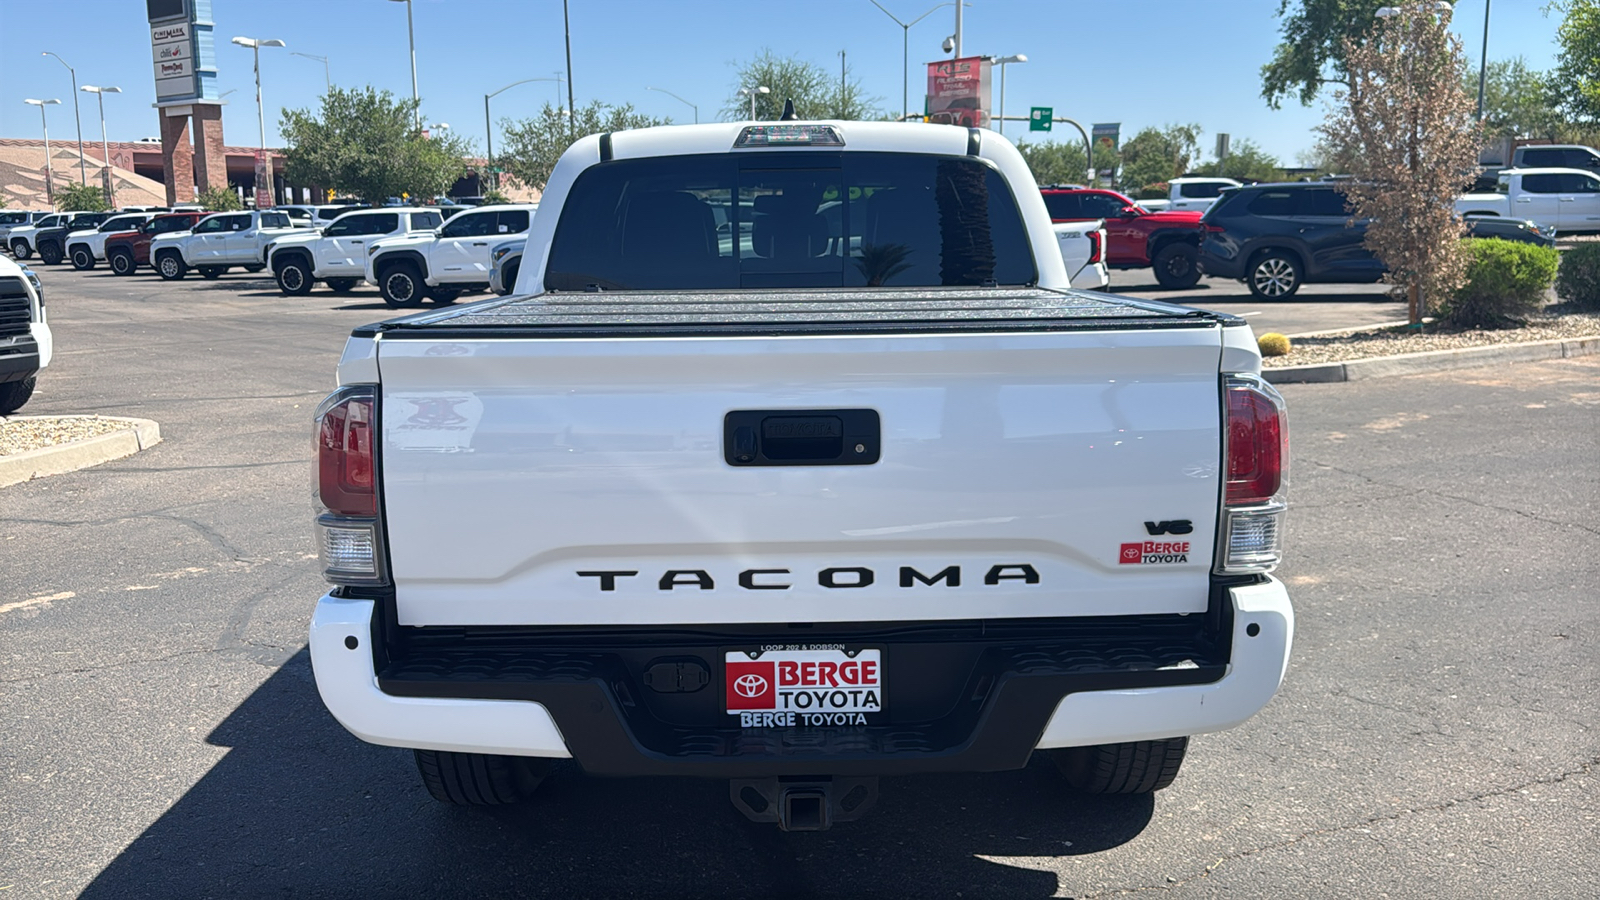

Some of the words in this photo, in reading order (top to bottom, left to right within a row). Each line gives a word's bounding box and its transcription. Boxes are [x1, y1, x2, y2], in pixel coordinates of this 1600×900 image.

[154, 28, 185, 40] CINEMARK
[769, 422, 836, 437] TOYOTA
[1144, 520, 1193, 535] V6
[1143, 541, 1190, 554] BERGE
[1142, 554, 1188, 564] TOYOTA
[575, 563, 1041, 592] TACOMA
[809, 643, 846, 651] DOBSON
[778, 661, 878, 687] BERGE
[778, 690, 880, 709] TOYOTA
[740, 711, 796, 728] BERGE
[801, 713, 868, 726] TOYOTA
